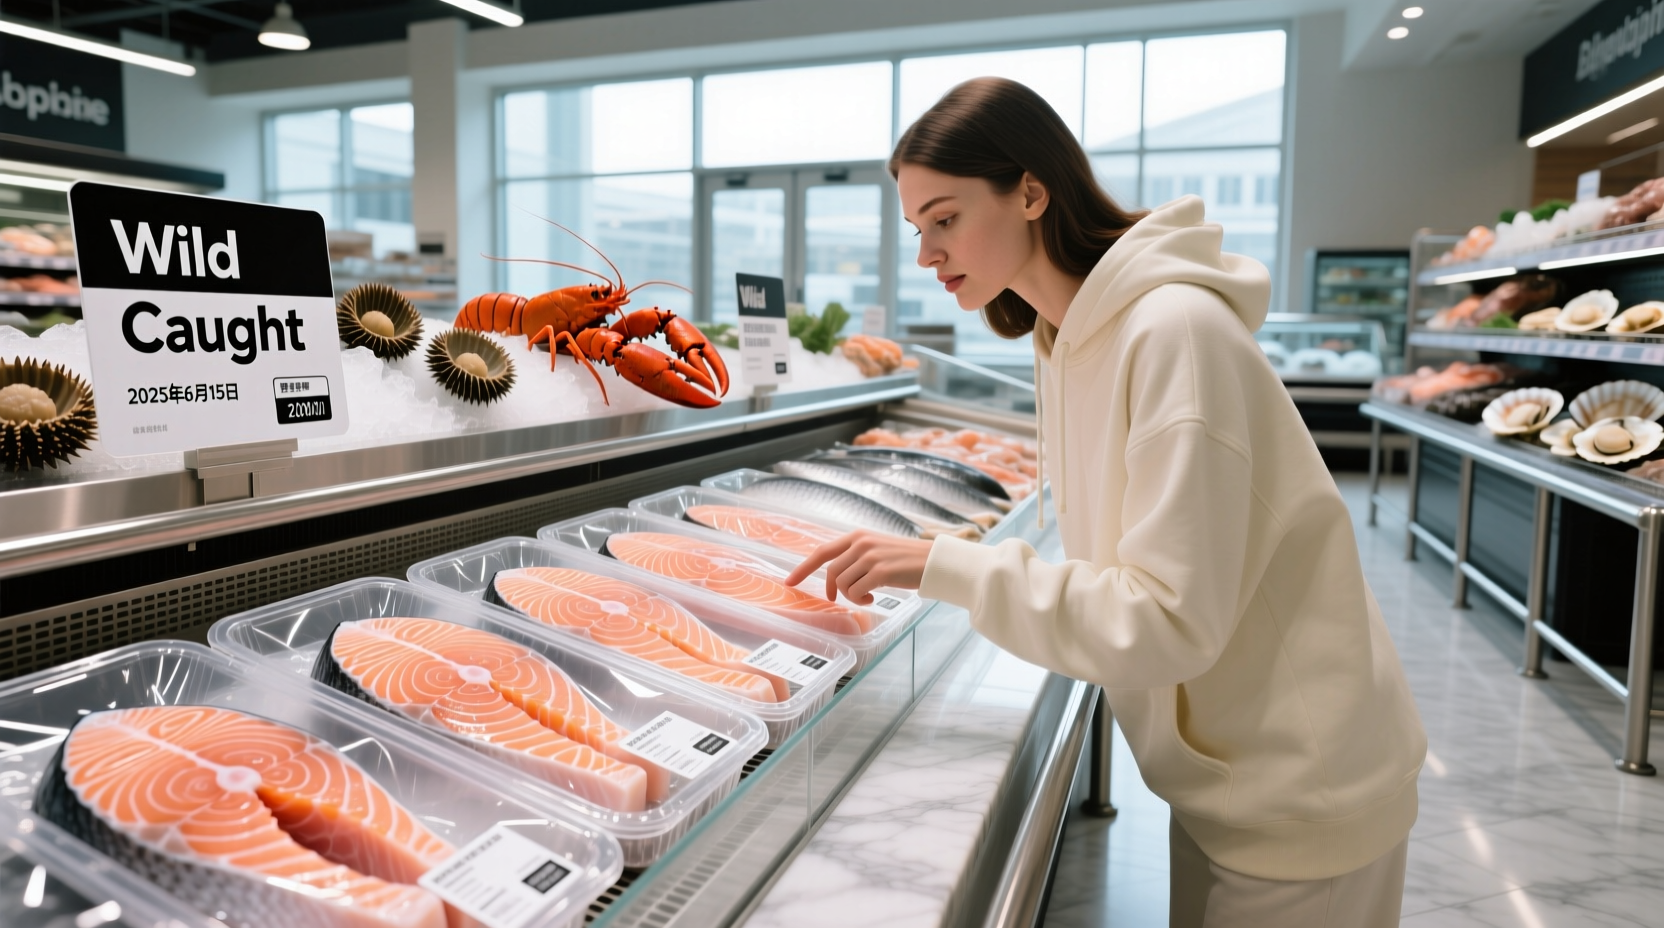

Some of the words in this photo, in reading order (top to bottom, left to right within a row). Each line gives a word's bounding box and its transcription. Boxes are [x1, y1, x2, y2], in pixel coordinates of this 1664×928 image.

[110, 219, 240, 279] Wild
[121, 301, 306, 364] Caught
[128, 382, 239, 405] 2025年6月15日
